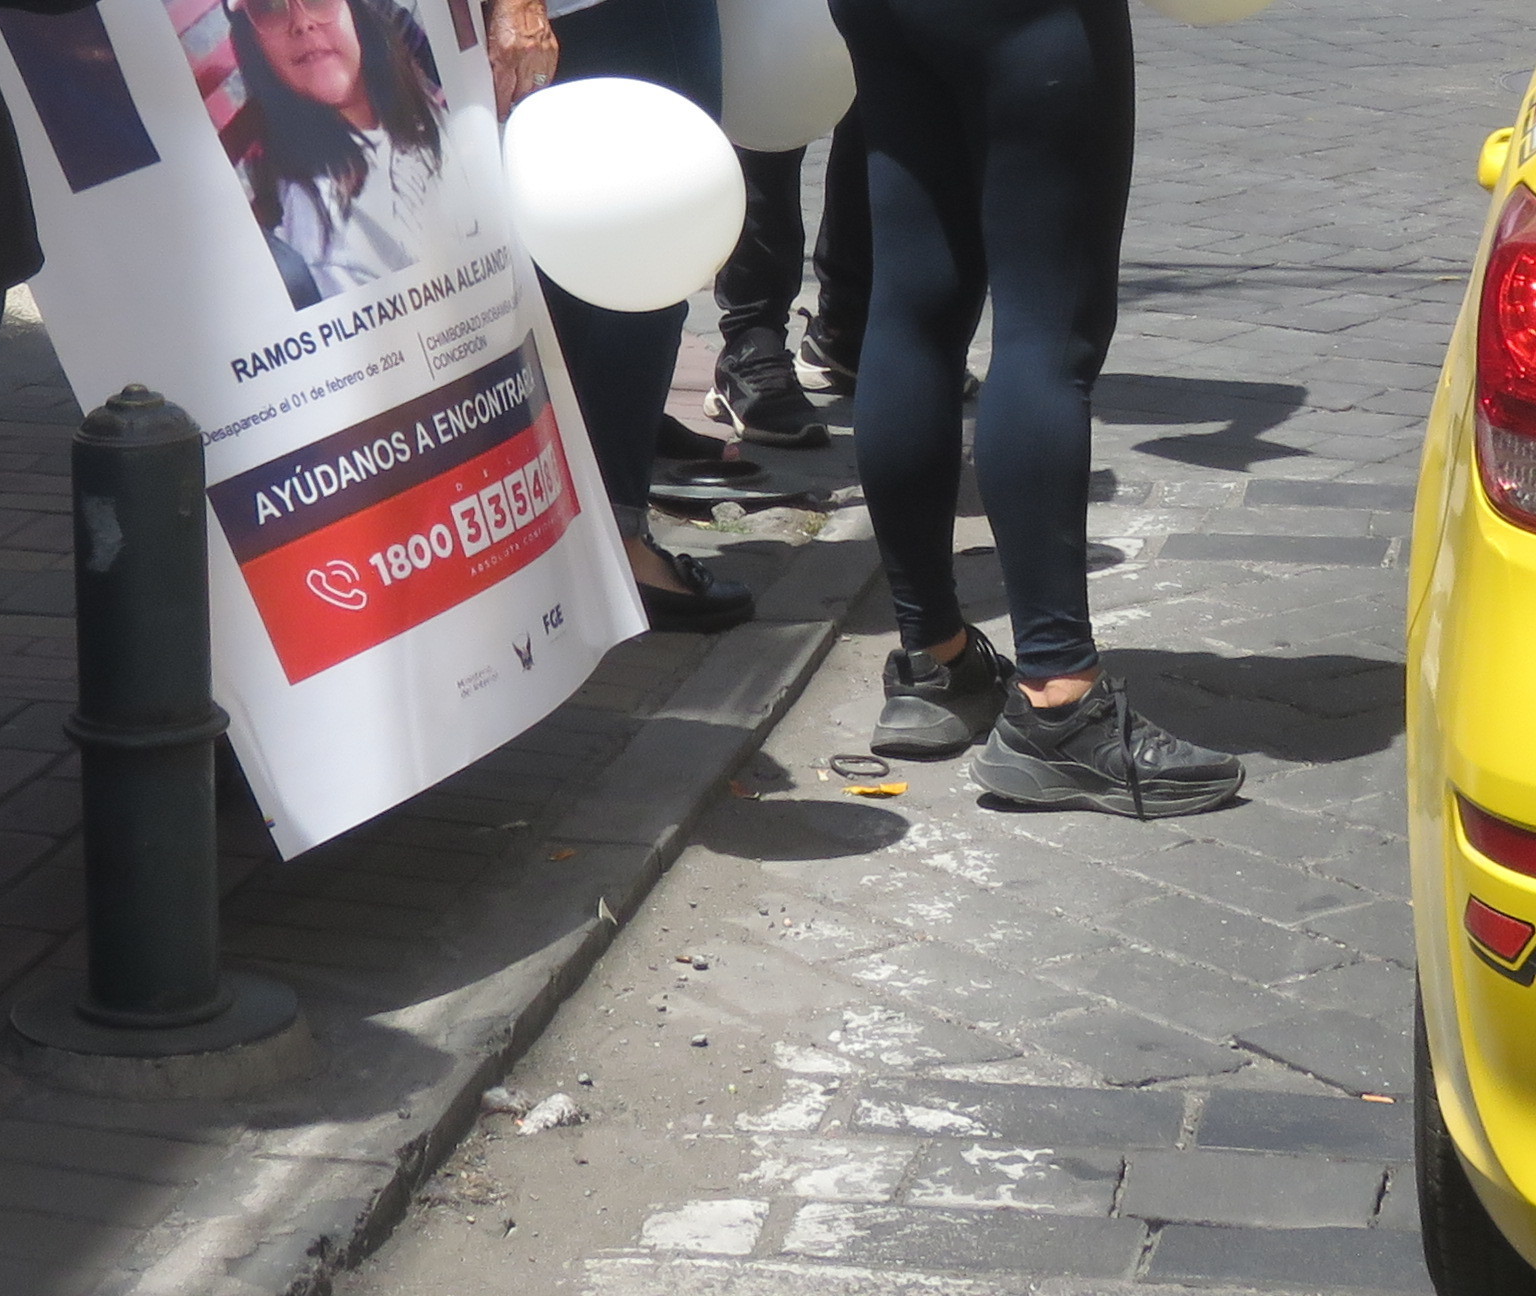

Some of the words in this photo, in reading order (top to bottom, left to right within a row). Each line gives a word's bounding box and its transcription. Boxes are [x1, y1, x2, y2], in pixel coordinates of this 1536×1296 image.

[230, 331, 317, 384] RAMOS
[318, 293, 408, 348] PILATAXI
[408, 276, 457, 312] DANA
[279, 397, 292, 414] el
[292, 391, 309, 408] 01
[310, 383, 325, 400] de
[326, 369, 365, 395] febrero
[366, 362, 380, 377] de
[380, 350, 406, 372] 2024
[255, 431, 412, 526] AYÚDANOS
[415, 422, 435, 455] A
[369, 523, 454, 587] 1800
[460, 446, 561, 545] 33548
